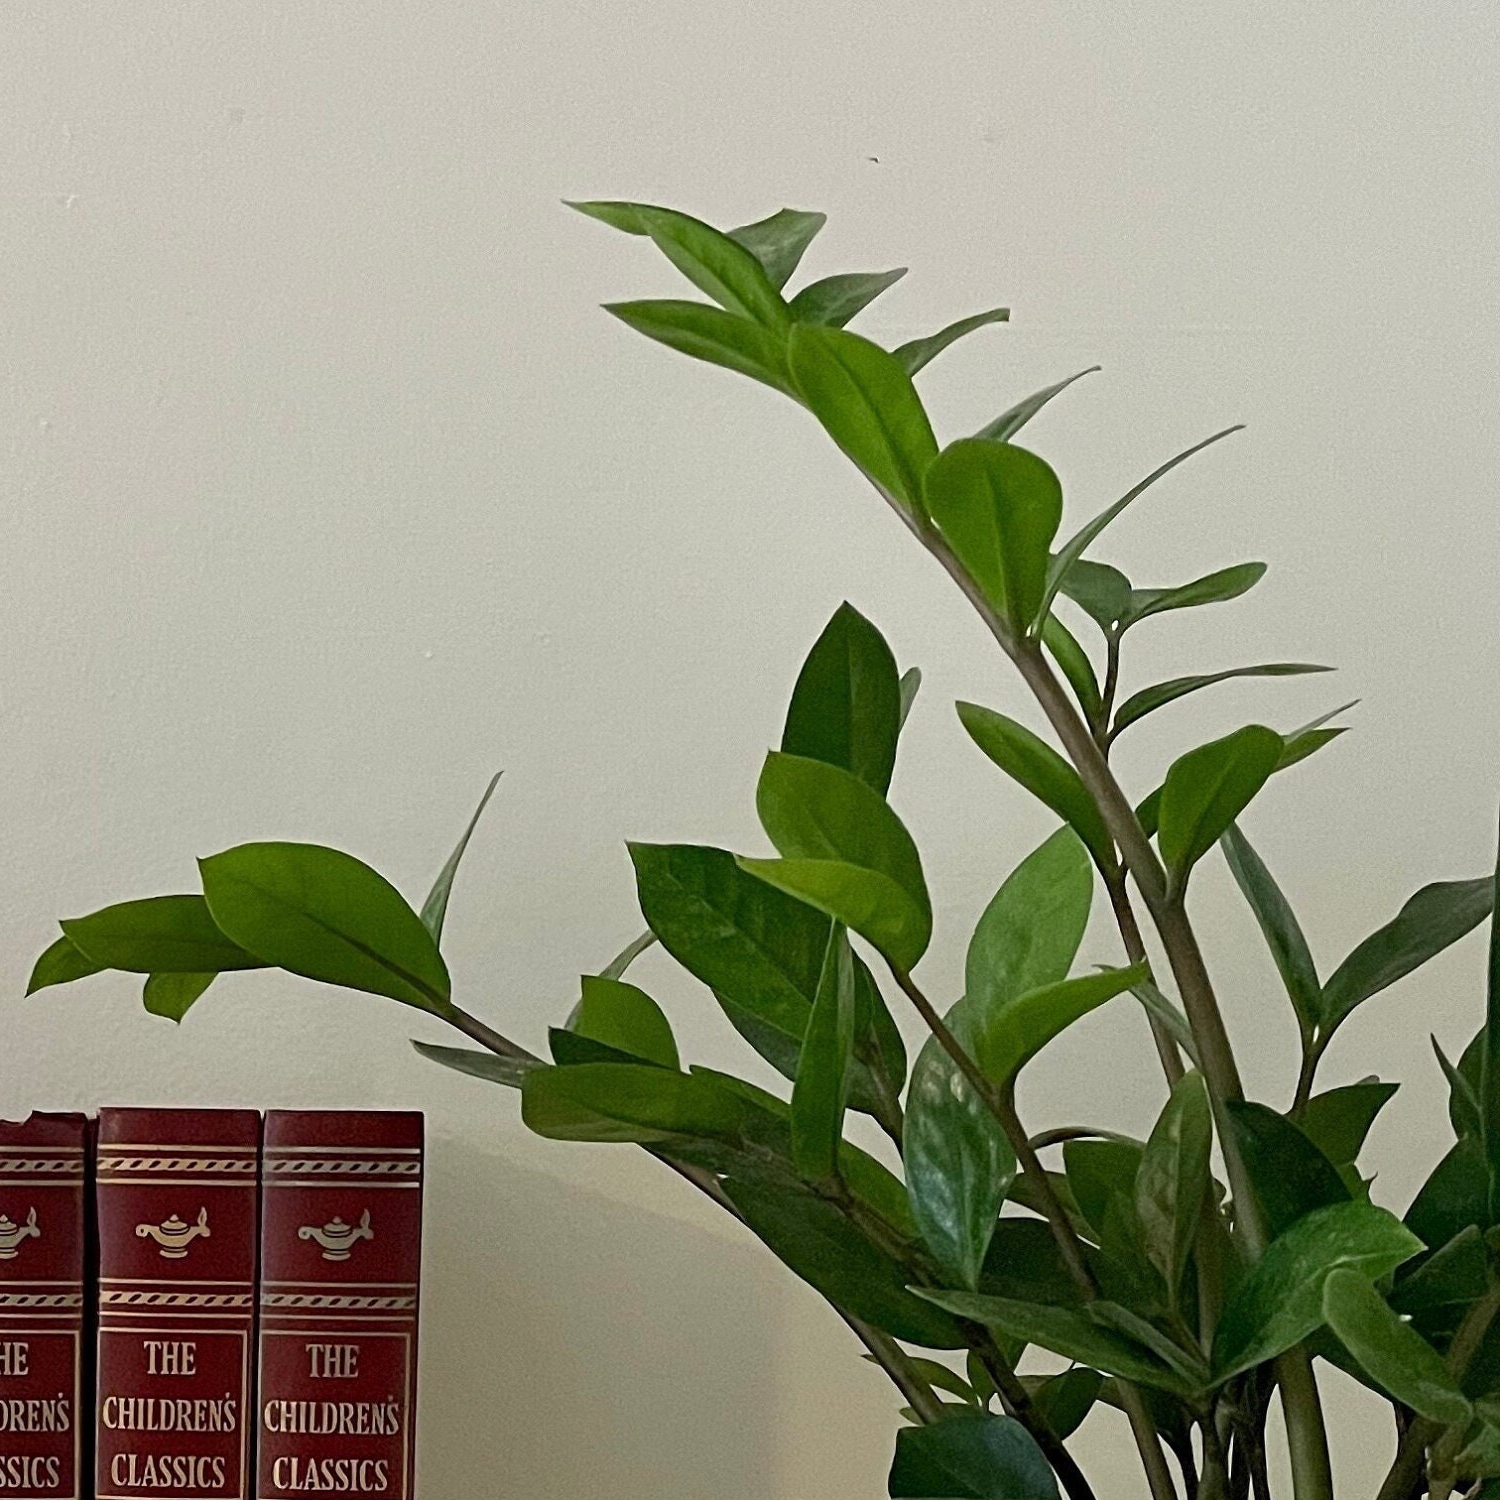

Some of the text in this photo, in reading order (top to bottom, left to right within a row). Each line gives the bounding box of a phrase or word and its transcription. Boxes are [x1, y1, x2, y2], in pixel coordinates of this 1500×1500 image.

[144, 1341, 195, 1375] THE
[306, 1344, 358, 1377] THE
[103, 1393, 236, 1431] CHILDREN'S
[265, 1395, 398, 1434] CHILDREN'S
[112, 1454, 224, 1487] CLASSICS
[273, 1457, 387, 1491] CLASSICS
